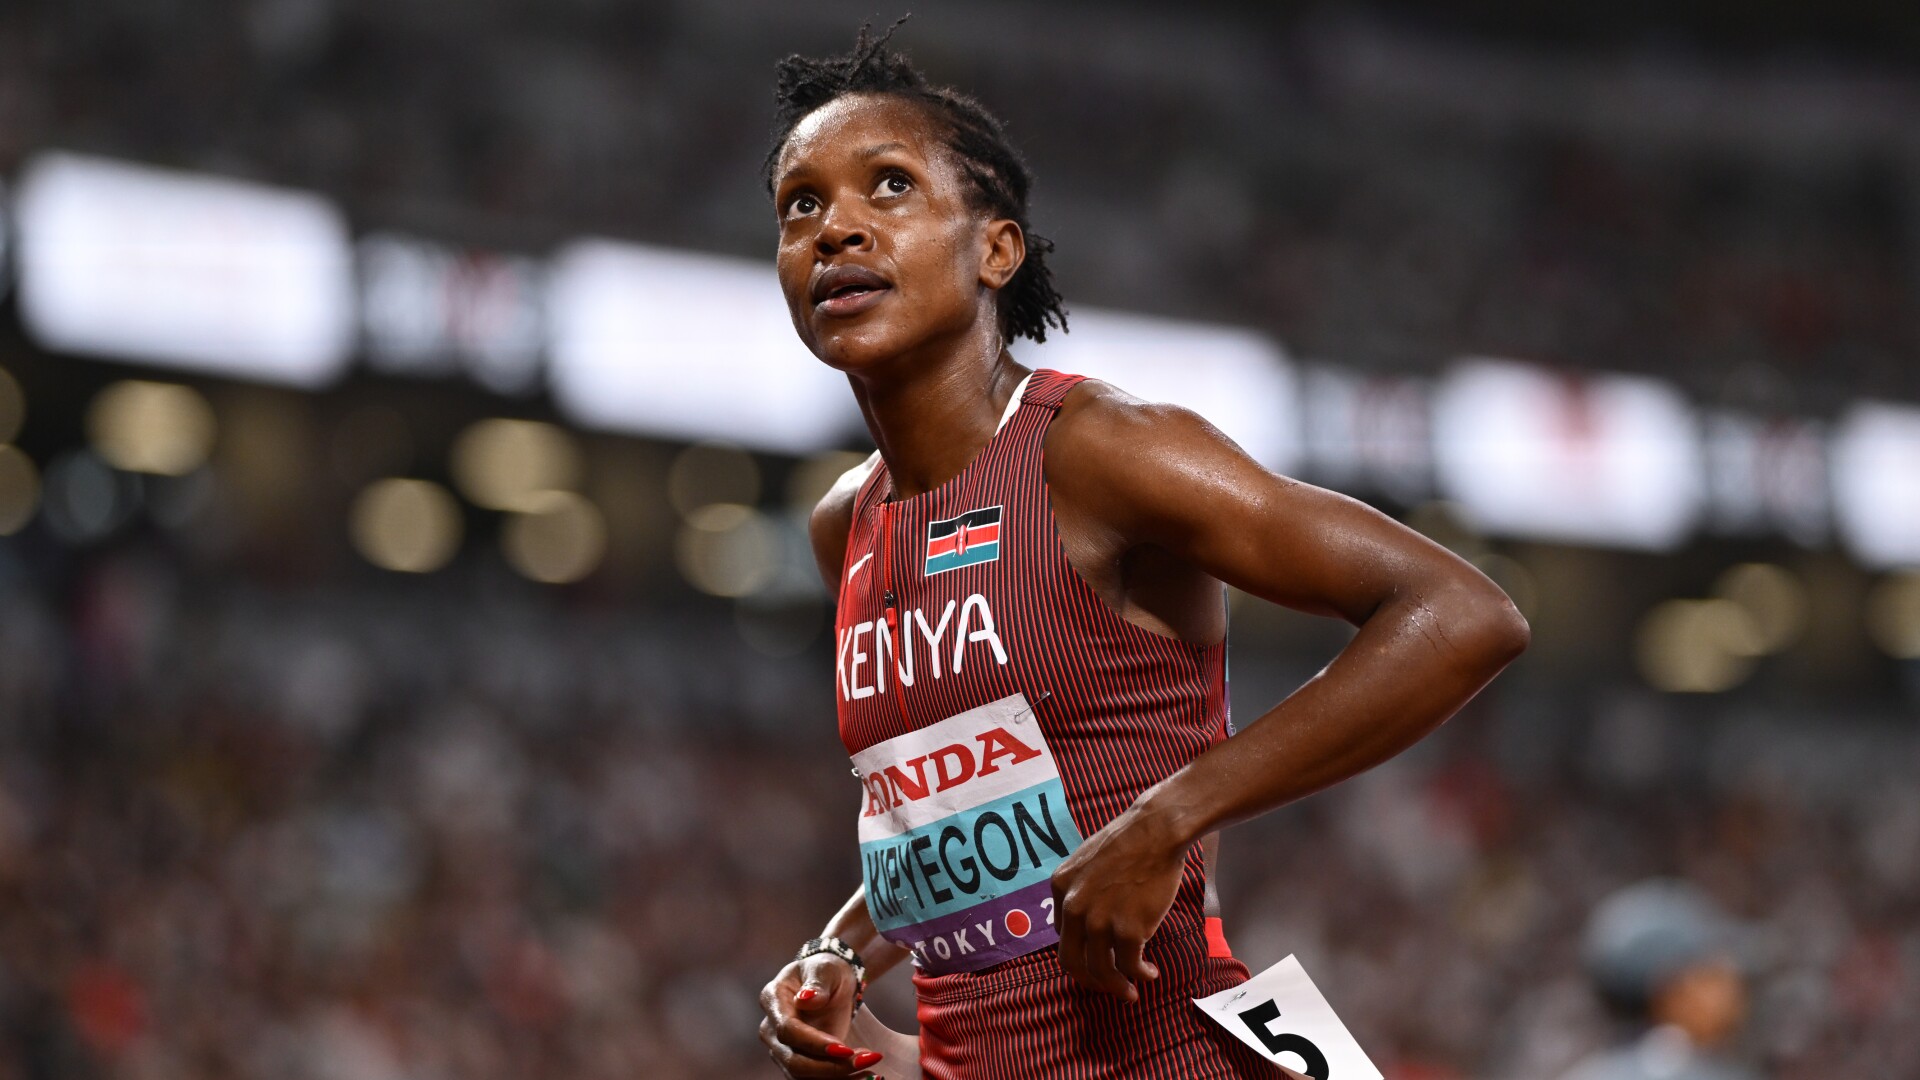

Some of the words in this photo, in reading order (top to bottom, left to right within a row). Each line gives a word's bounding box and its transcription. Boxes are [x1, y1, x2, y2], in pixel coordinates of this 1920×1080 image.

[837, 593, 1008, 702] KENYA
[863, 727, 1042, 817] HONDA
[867, 793, 1070, 920] KIPYEGON
[1237, 998, 1330, 1080] 5
